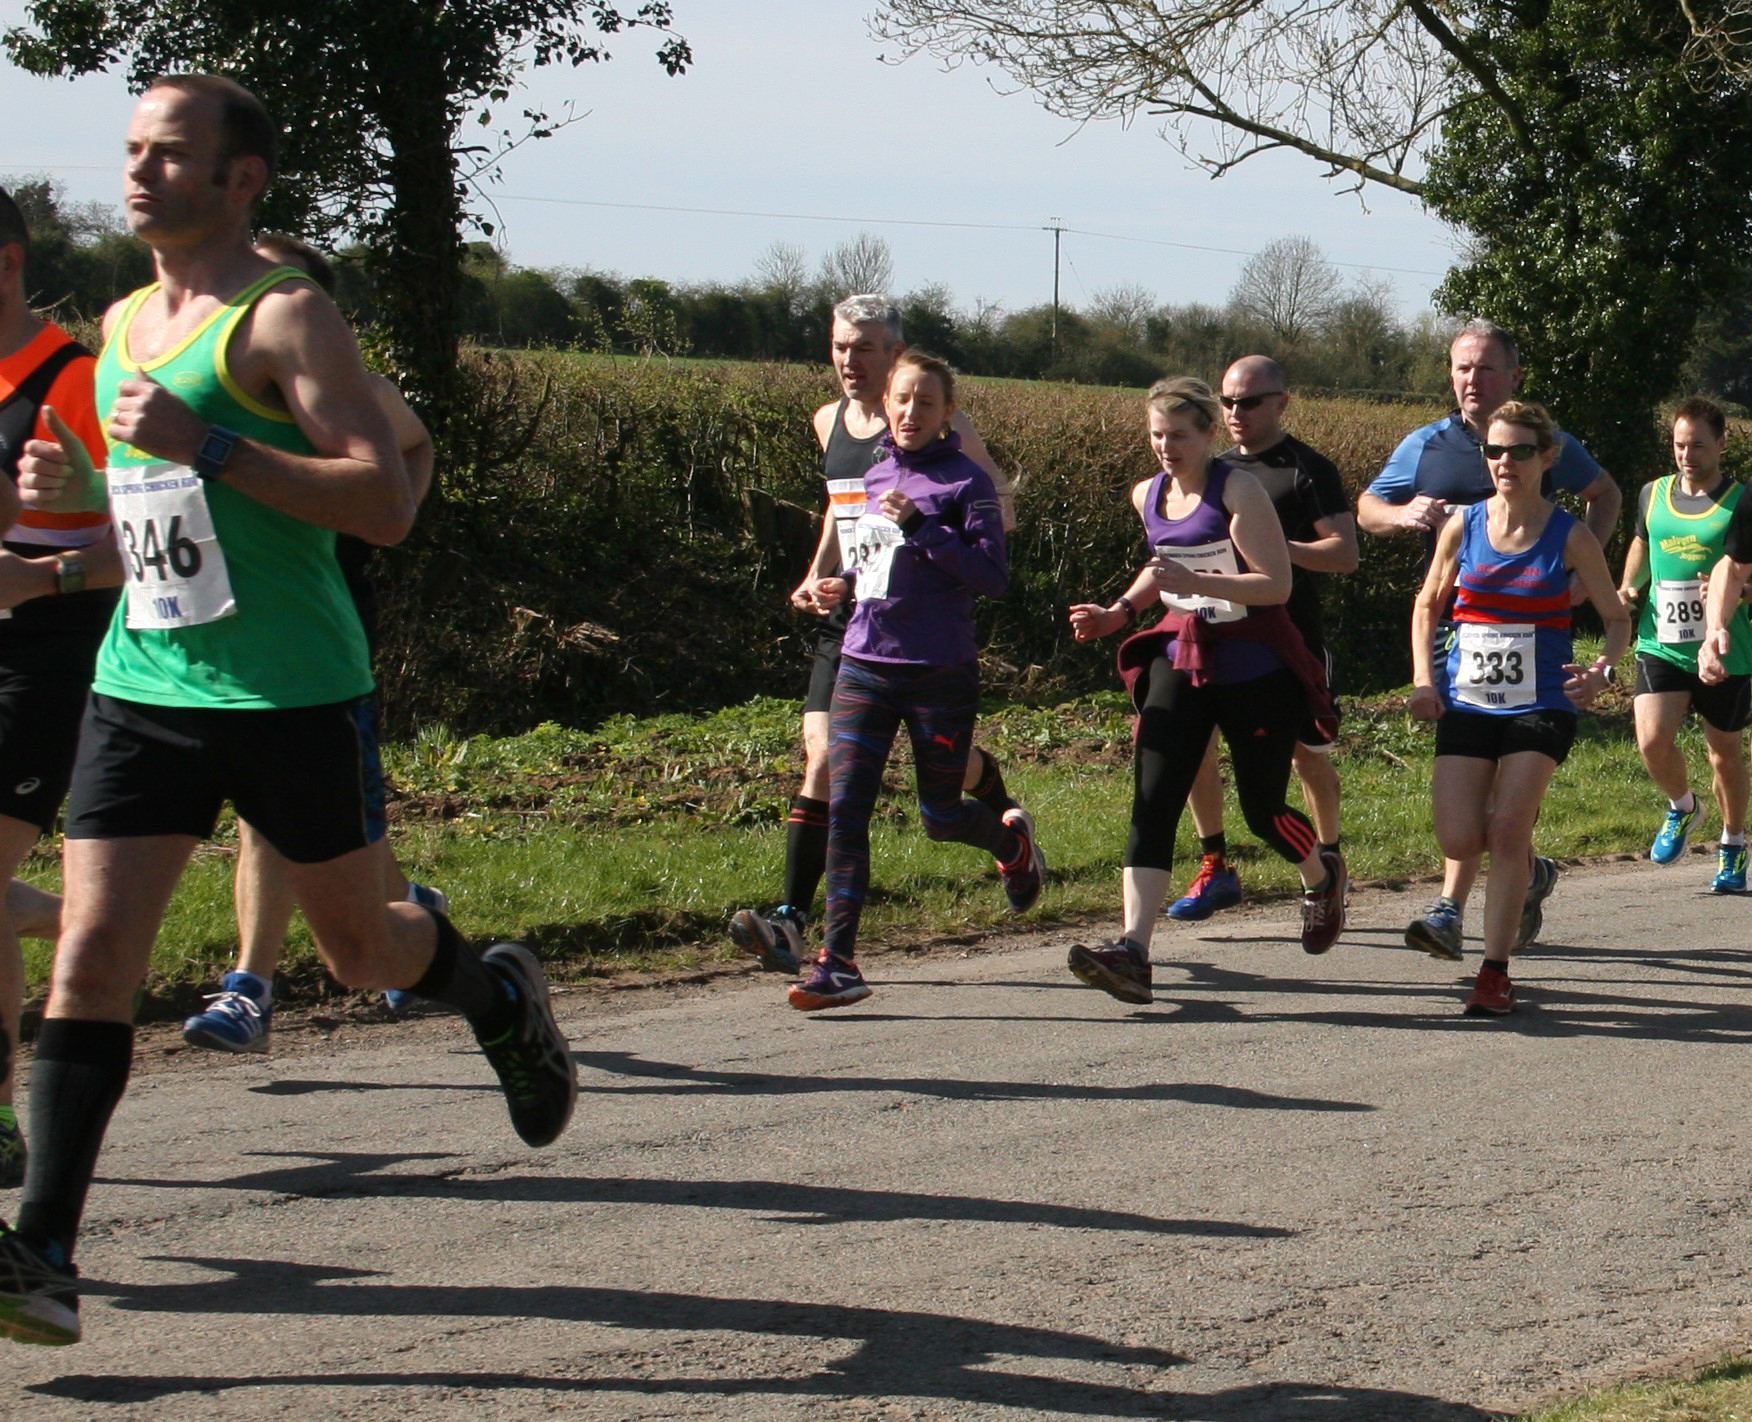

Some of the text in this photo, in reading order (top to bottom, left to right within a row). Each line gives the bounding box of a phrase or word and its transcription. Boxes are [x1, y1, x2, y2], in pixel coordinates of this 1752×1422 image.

[122, 515, 202, 583] 346
[152, 596, 183, 619] 10K
[1195, 606, 1217, 619] 10K
[1666, 600, 1704, 624] 289
[1679, 629, 1695, 639] 10K
[1470, 651, 1524, 685] 333
[1485, 692, 1507, 704] 10K
